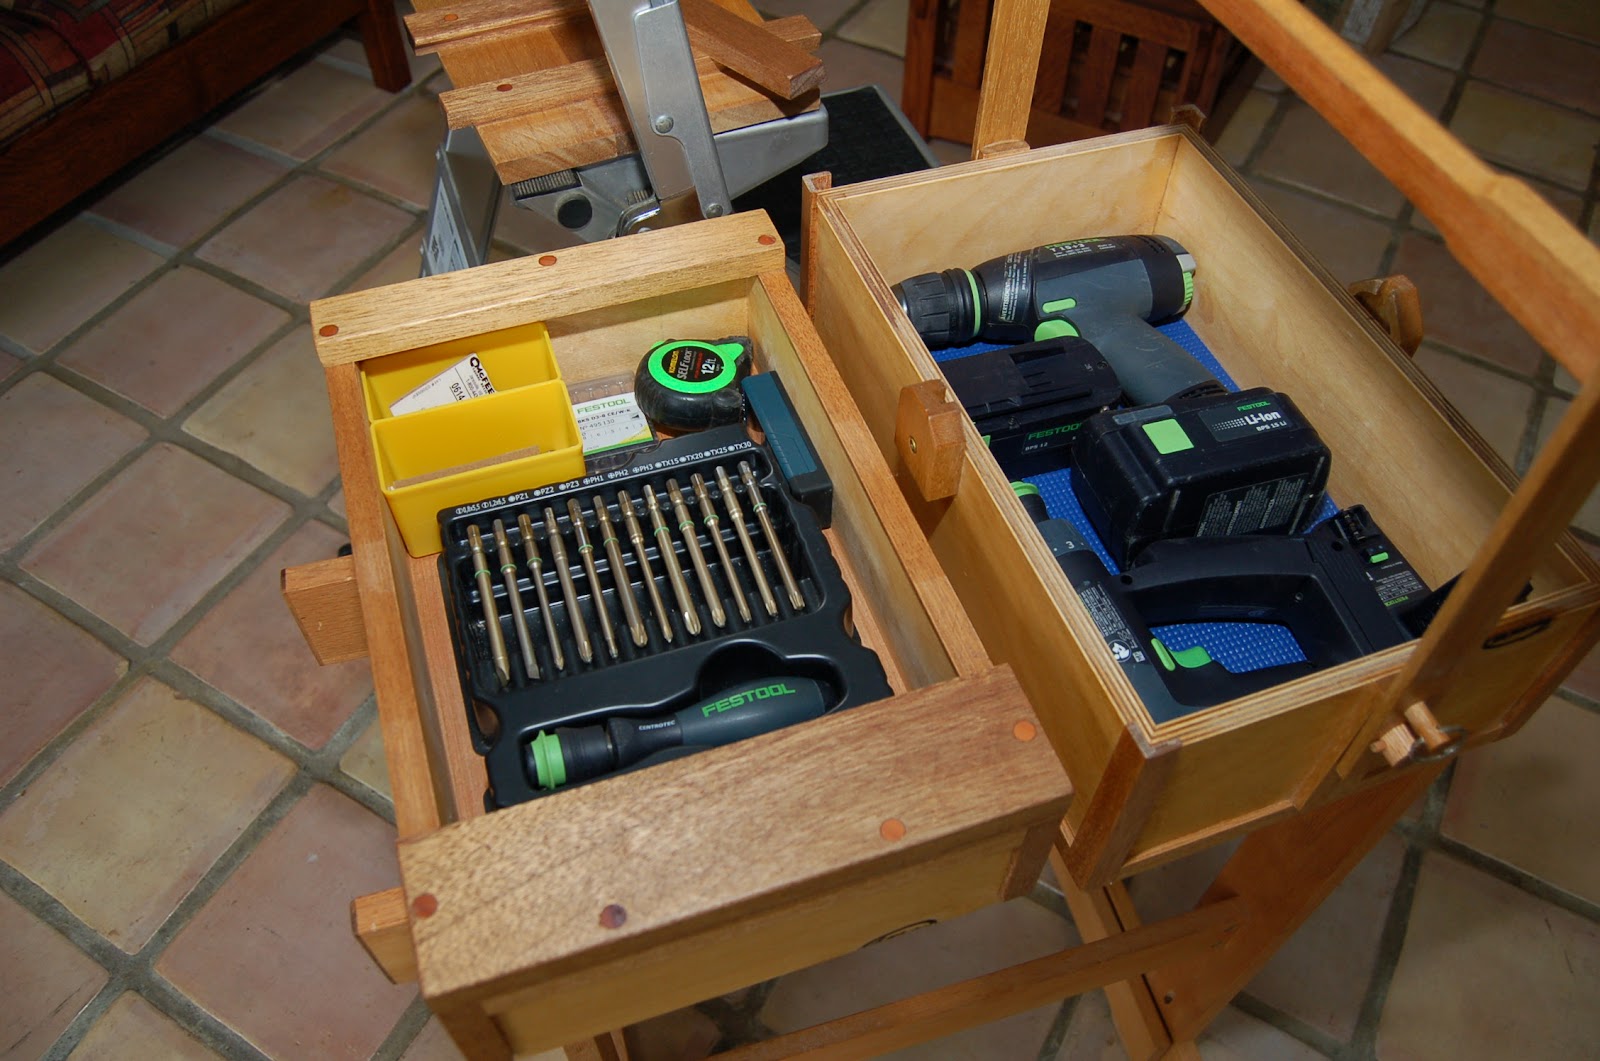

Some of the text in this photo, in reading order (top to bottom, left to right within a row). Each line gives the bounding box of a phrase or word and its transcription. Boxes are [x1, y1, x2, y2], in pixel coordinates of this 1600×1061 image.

[451, 382, 466, 401] 0614
[576, 399, 631, 414] FESTOOL
[1237, 401, 1271, 412] FESTOOL
[1245, 411, 1282, 425] Li-Ion
[1028, 423, 1082, 440] FESTOO
[515, 492, 529, 501] PZ1
[540, 486, 555, 496] PZ2
[565, 480, 580, 489] PZ3
[590, 474, 604, 484] PH1
[614, 469, 629, 478] PH2
[639, 463, 654, 472] PH3
[661, 458, 680, 468] TX15
[685, 452, 704, 462] TX20
[710, 446, 728, 456] TX25
[734, 441, 752, 451] TX30
[1065, 541, 1075, 549] 3
[702, 683, 796, 718] FESTOOL
[638, 719, 676, 731] CENTROTEC
